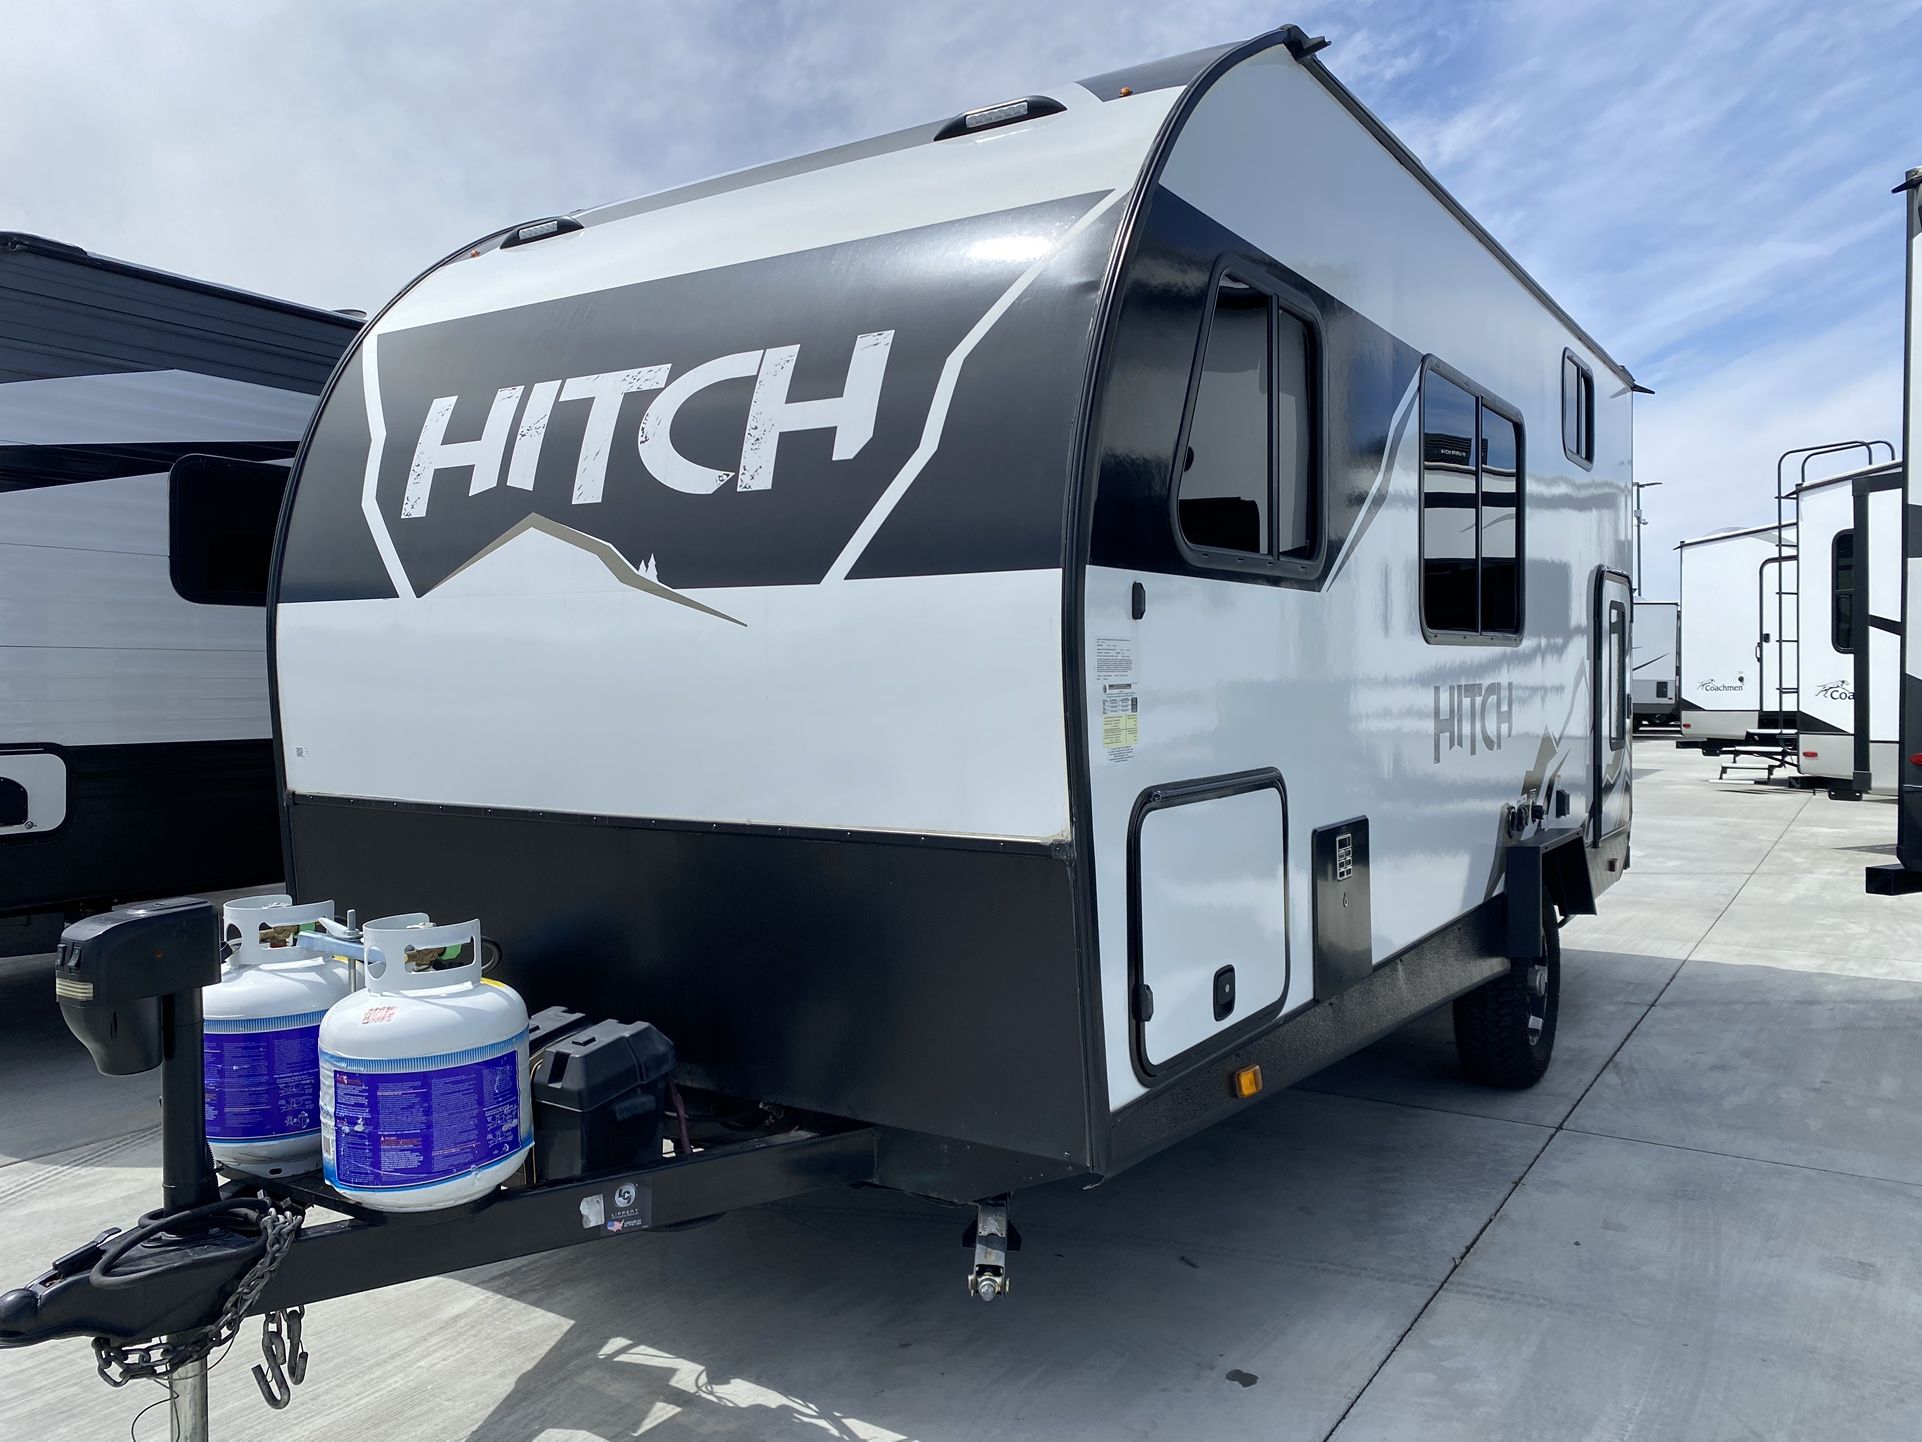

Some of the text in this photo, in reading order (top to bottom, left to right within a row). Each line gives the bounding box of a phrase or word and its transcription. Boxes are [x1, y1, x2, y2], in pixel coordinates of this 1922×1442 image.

[401, 329, 895, 519] HITCH
[1433, 681, 1513, 764] HITCH
[1704, 684, 1743, 692] Coachmen
